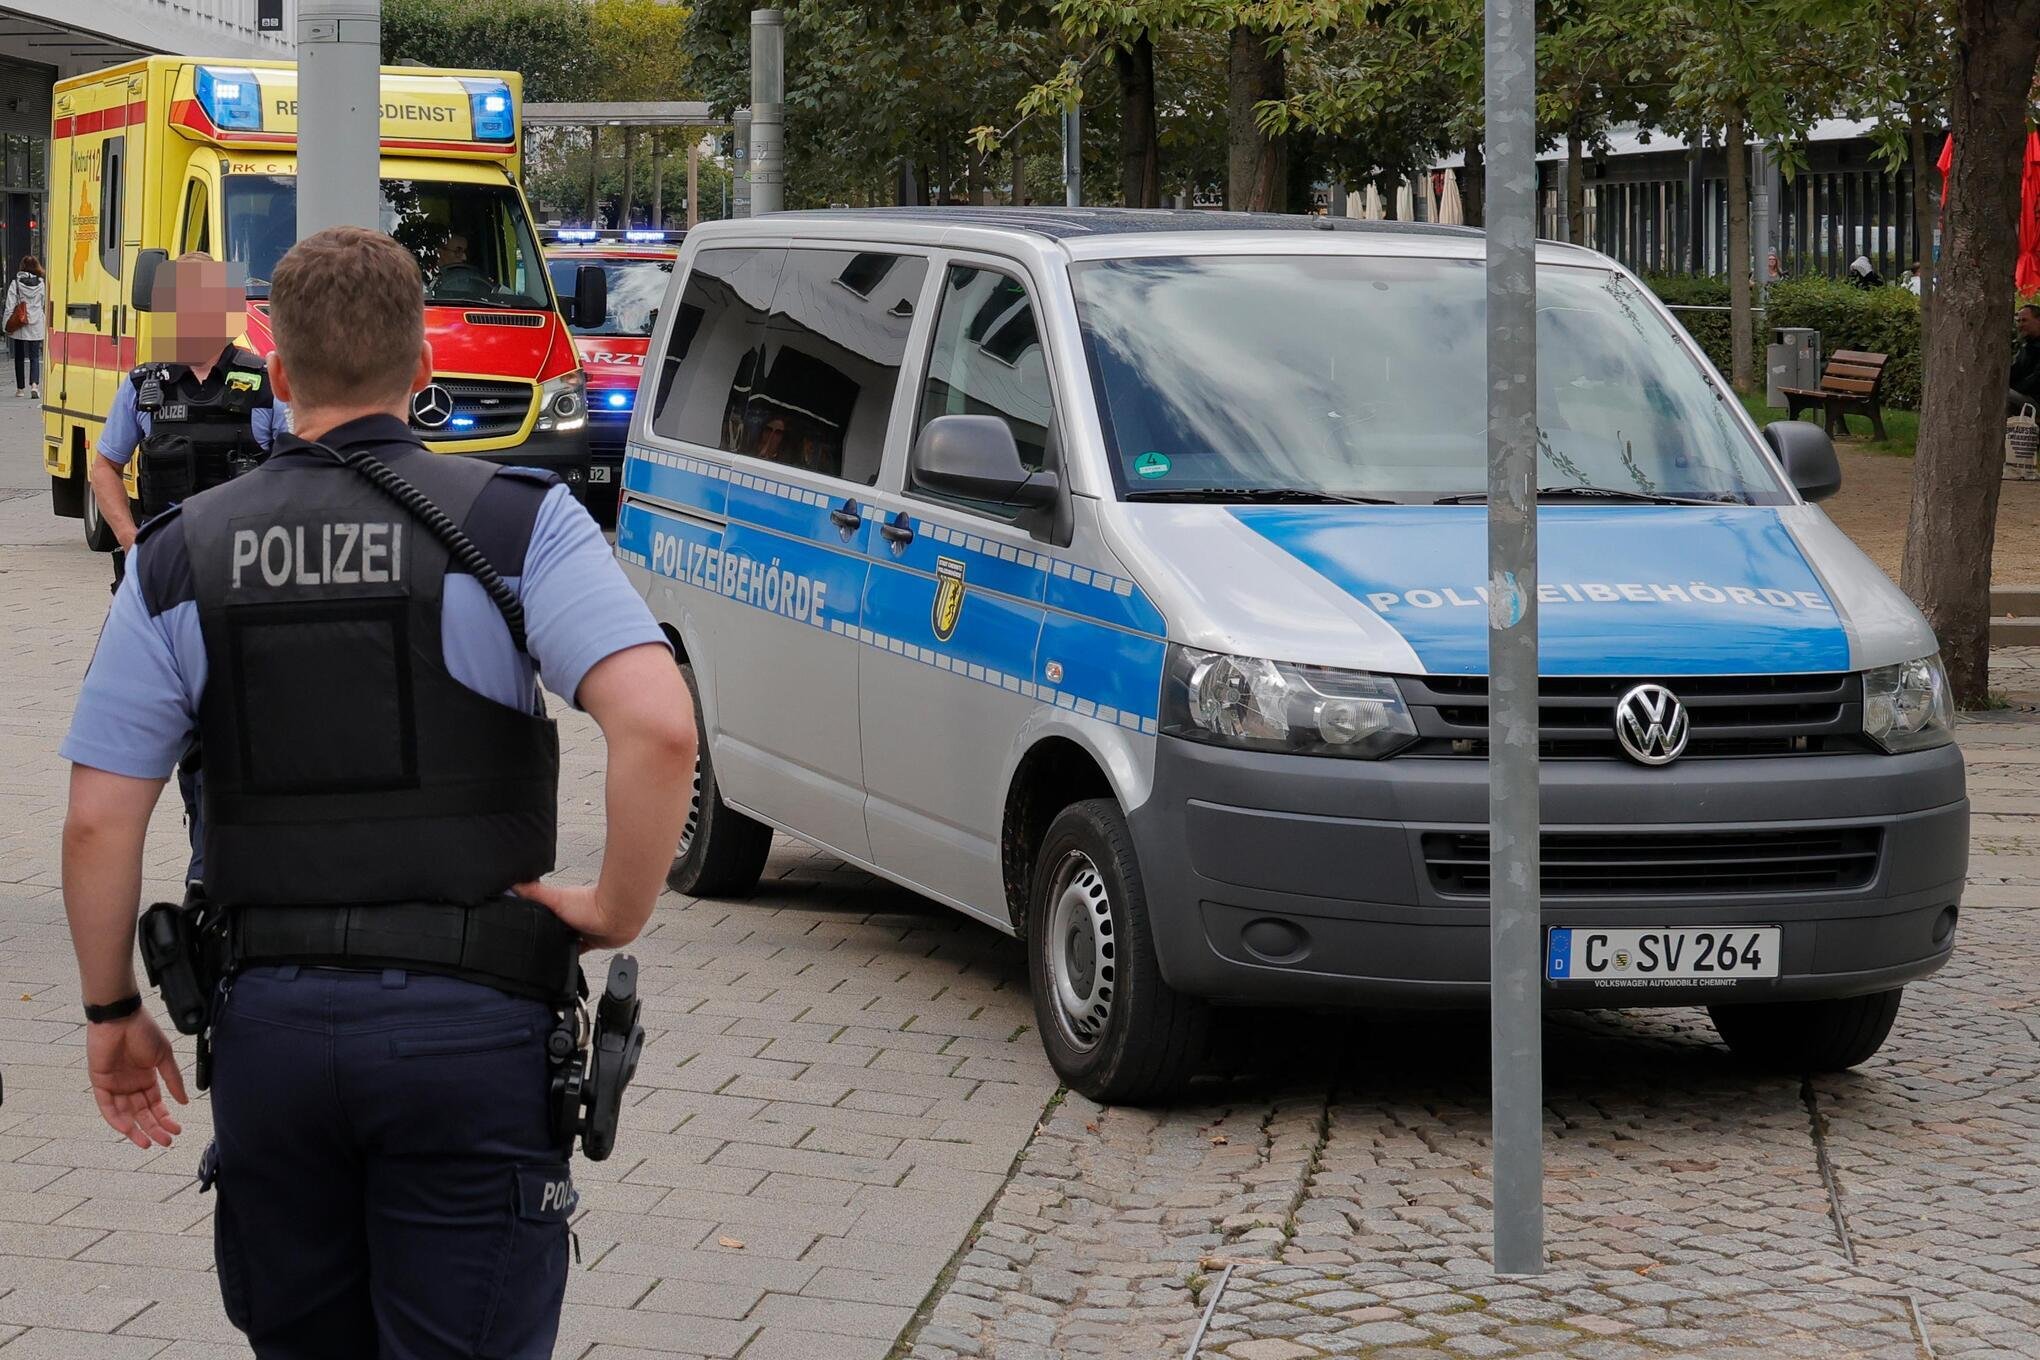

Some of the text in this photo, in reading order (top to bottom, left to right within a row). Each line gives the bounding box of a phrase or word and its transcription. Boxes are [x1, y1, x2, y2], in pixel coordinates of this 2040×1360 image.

[276, 100, 456, 122] REDIENST
[1147, 454, 1157, 465] 4
[232, 523, 403, 589] POLIZEI
[652, 531, 828, 628] POLIZEIBEHÖRDE
[1366, 580, 1832, 612] POLIEIBEHÖRDE
[1617, 685, 1688, 764] VW
[1555, 933, 1762, 972] D C SV 264
[1594, 978, 1737, 988] VOLKSWAGEN AUTOMOBILE CHEMNITZ
